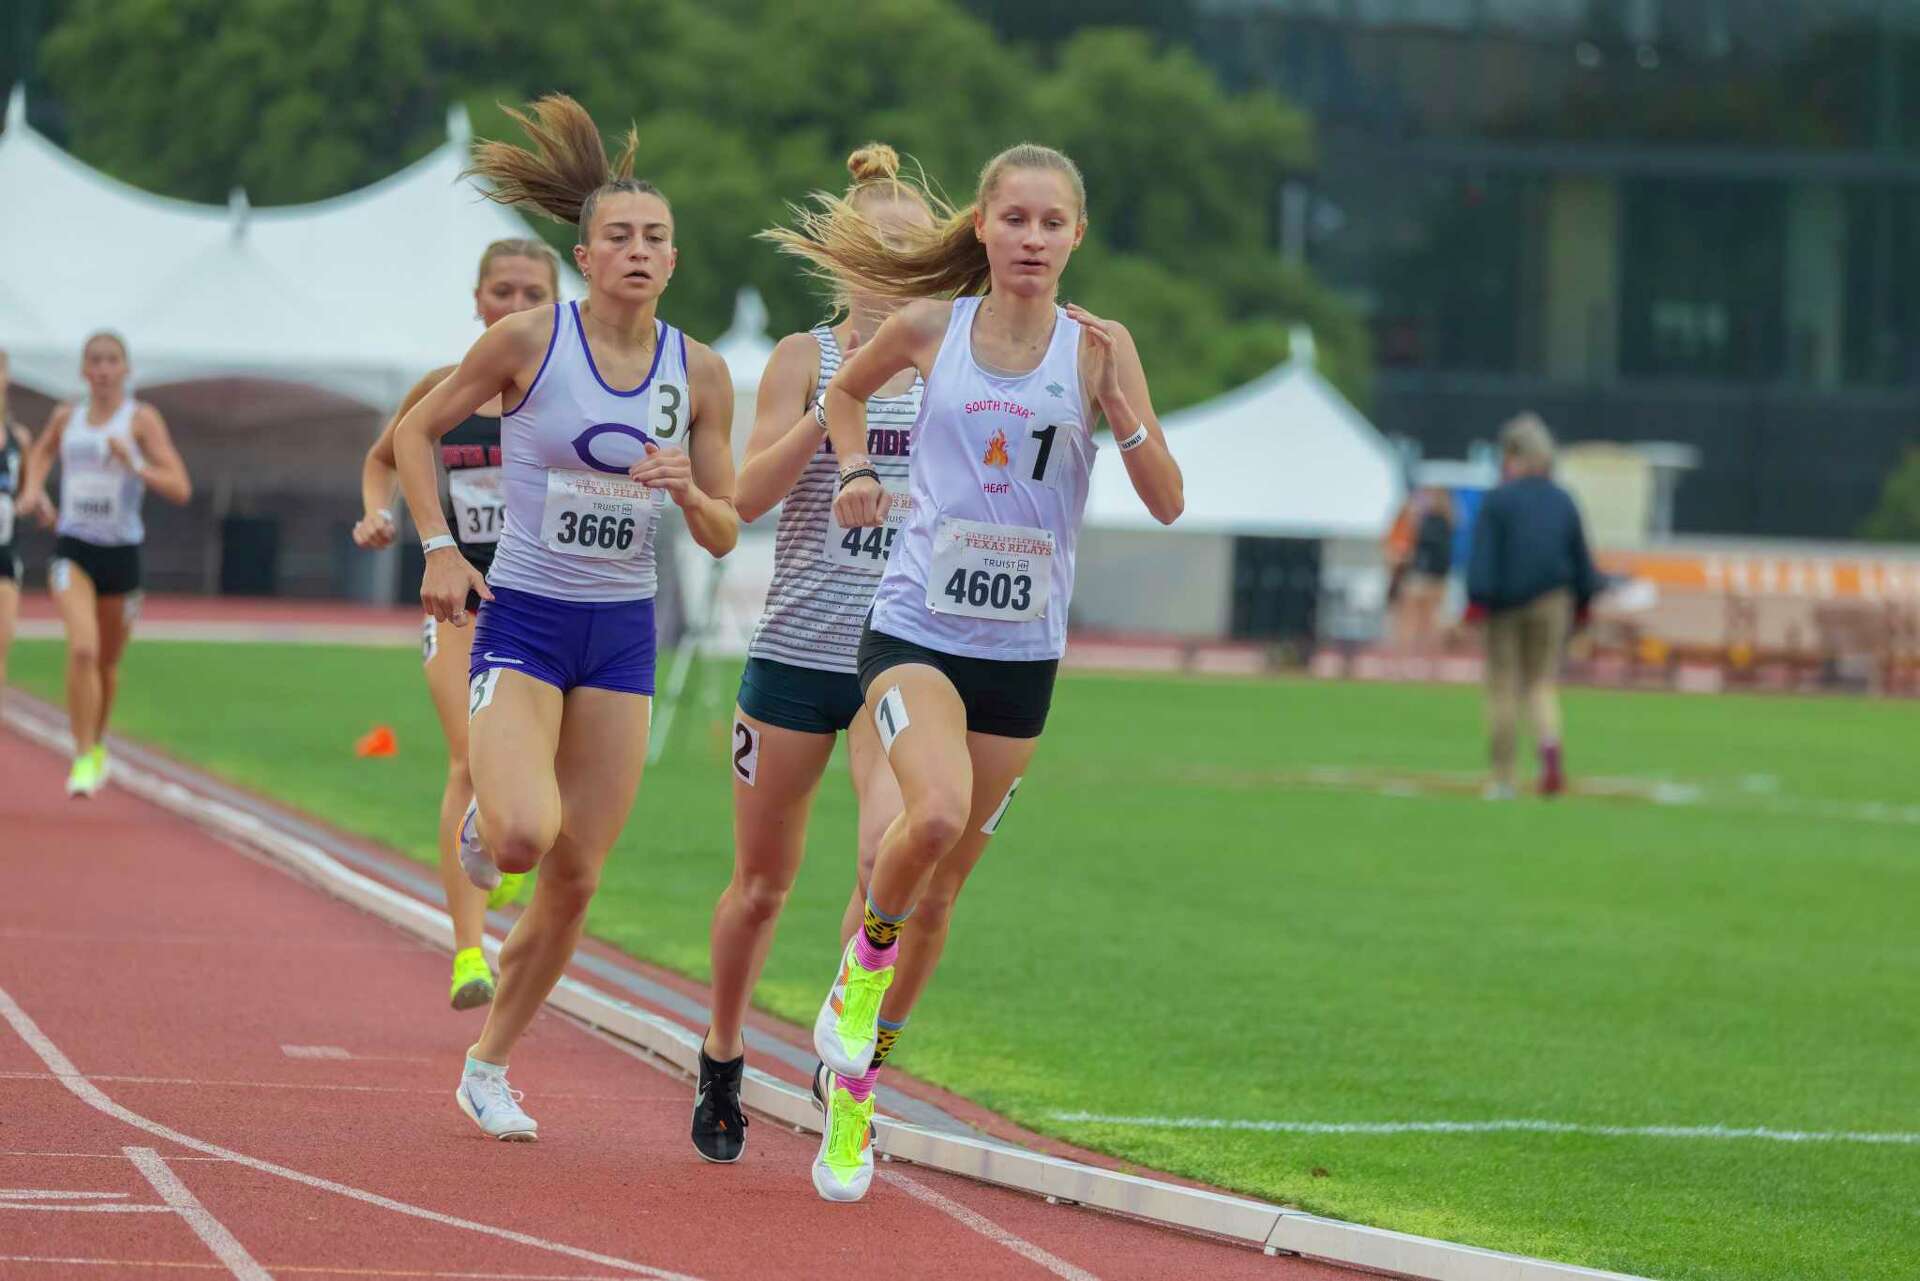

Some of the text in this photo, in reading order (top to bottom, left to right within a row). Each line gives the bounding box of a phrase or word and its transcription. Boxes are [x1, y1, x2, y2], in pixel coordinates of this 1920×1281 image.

[655, 383, 682, 439] 3
[965, 400, 1001, 414] SOUTH
[570, 422, 660, 475] C
[1031, 424, 1058, 482] 1
[576, 484, 612, 496] TEXAS
[613, 488, 652, 499] RELAYS
[593, 502, 620, 512] TRUIST
[983, 483, 1009, 494] HEAT
[557, 511, 636, 550] 3666
[965, 538, 1052, 557] TEXAS RELAYS
[983, 558, 1016, 569] TRUIST
[944, 568, 1032, 611] 4603
[879, 698, 896, 737] 1
[733, 722, 753, 779] 2
